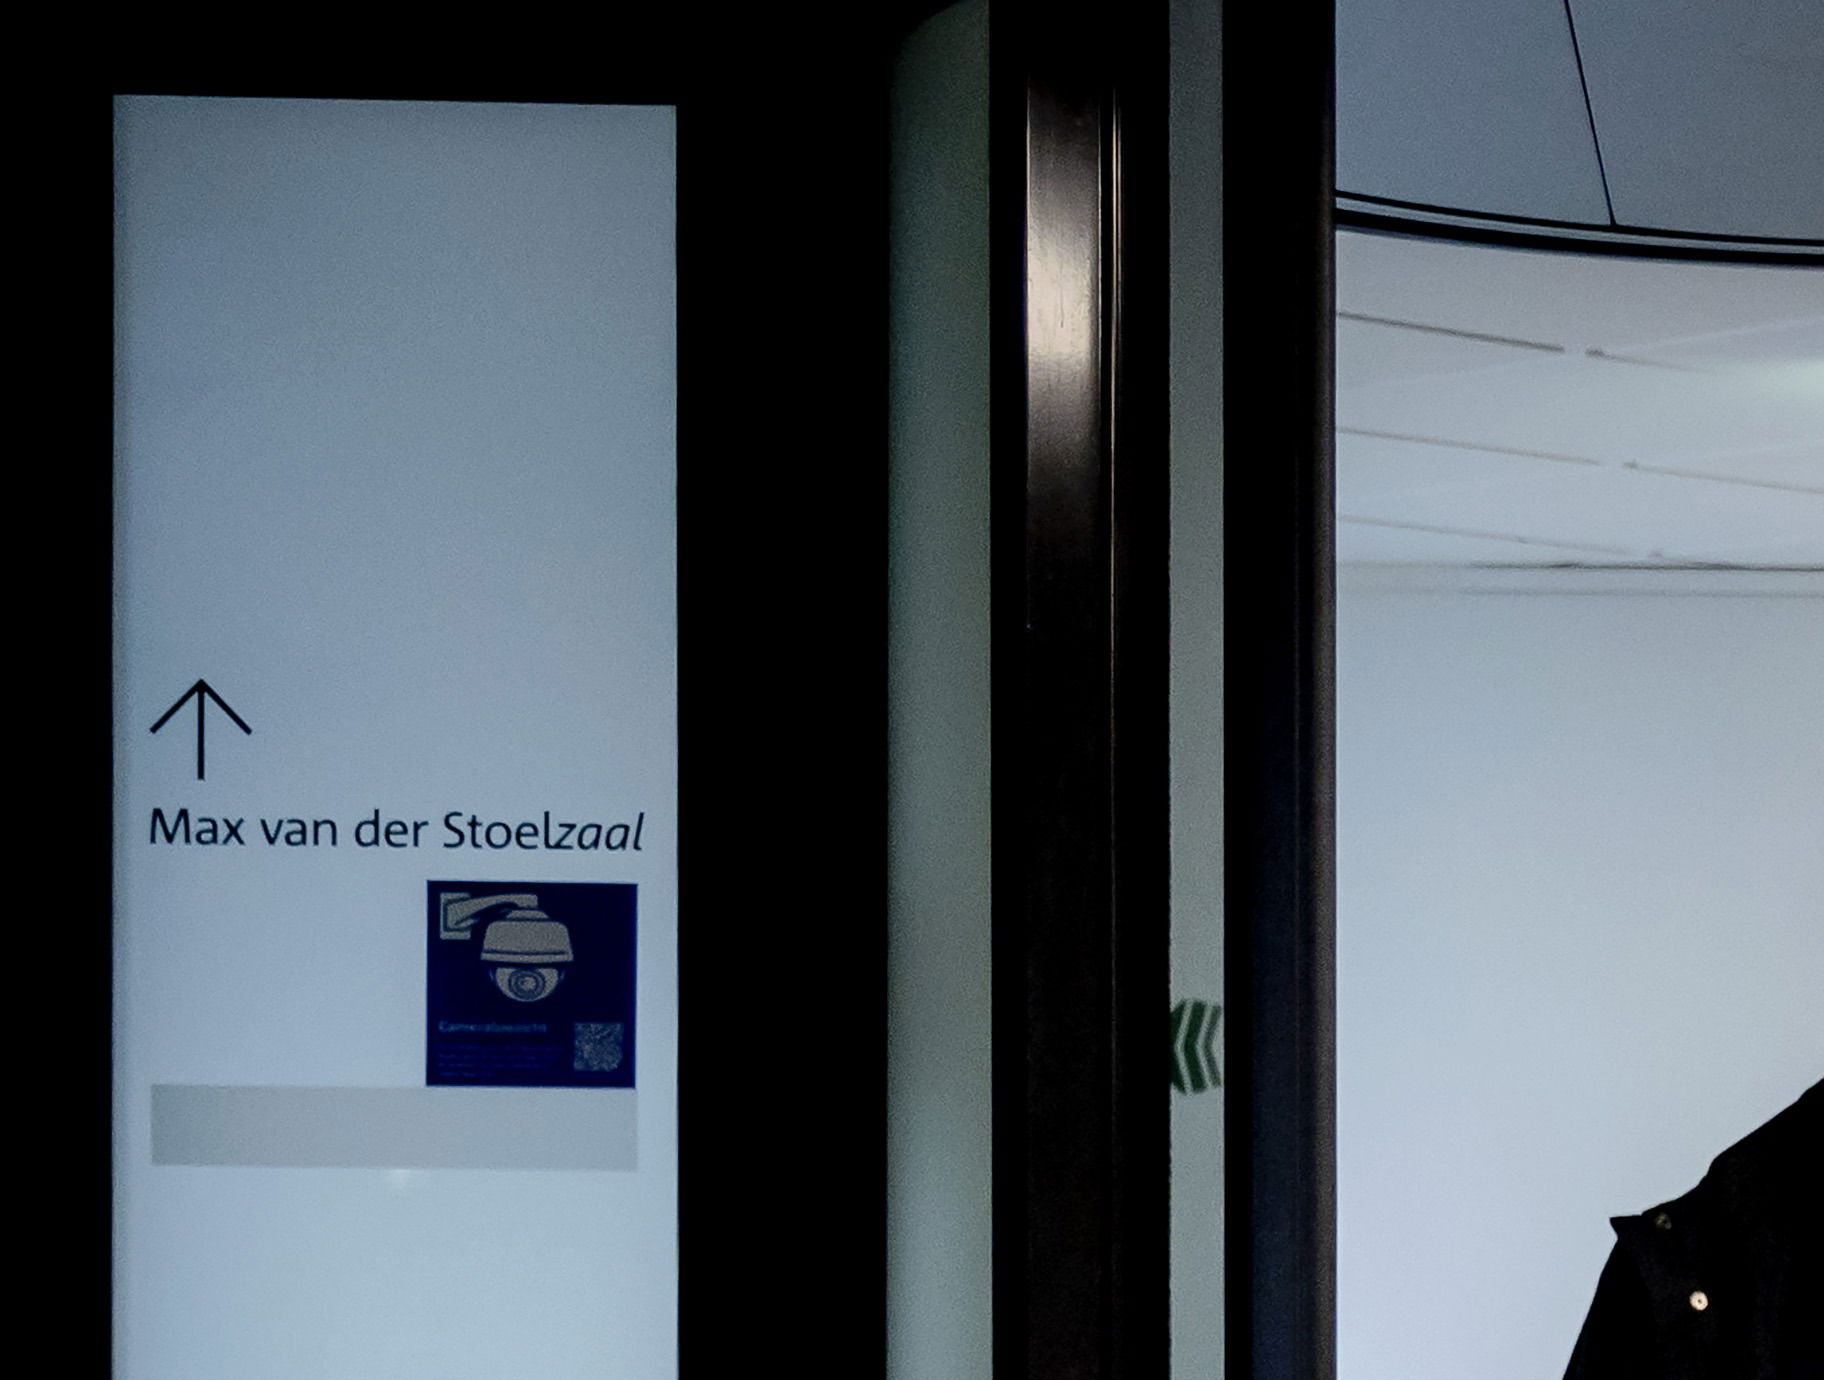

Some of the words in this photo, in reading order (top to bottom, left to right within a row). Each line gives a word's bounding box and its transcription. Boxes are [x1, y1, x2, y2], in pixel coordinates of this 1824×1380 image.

[149, 806, 245, 846] Max
[260, 817, 338, 847] van
[353, 807, 430, 848] der
[442, 810, 645, 851] Stoelzaal
